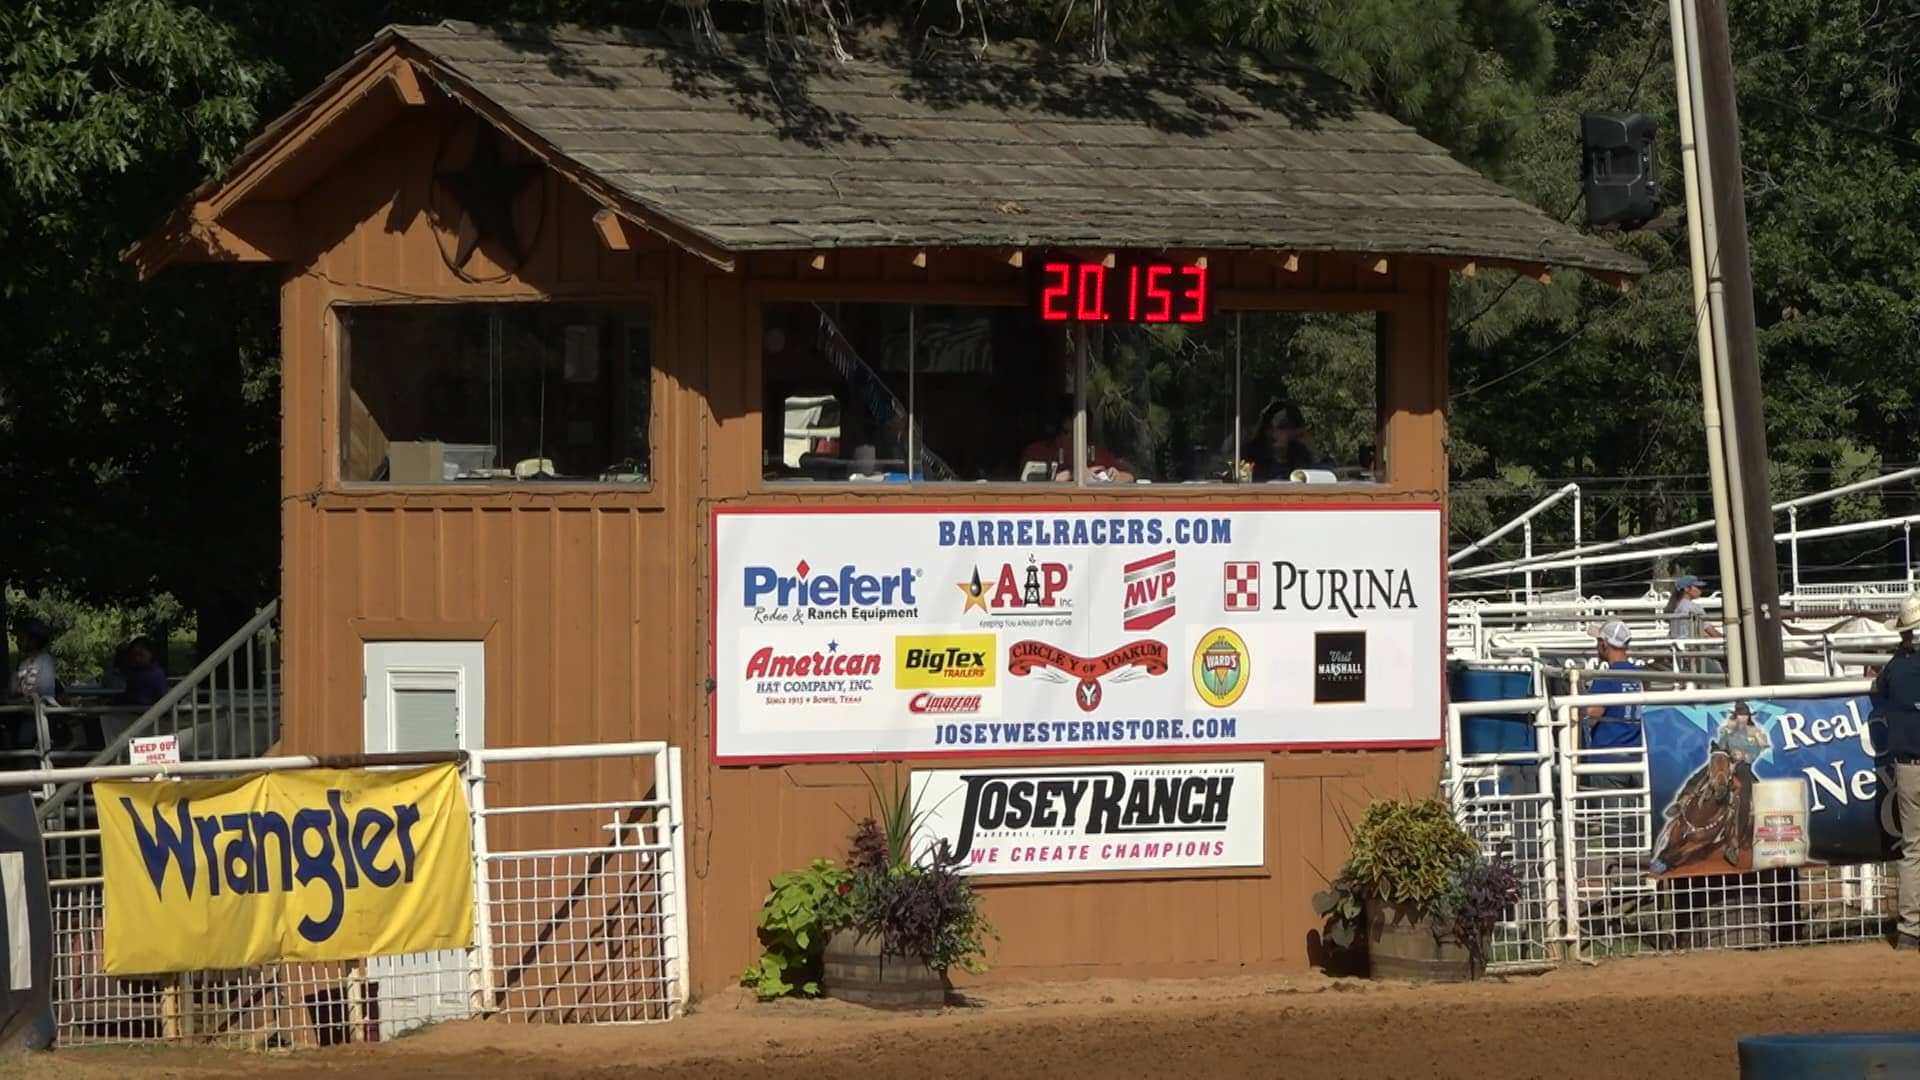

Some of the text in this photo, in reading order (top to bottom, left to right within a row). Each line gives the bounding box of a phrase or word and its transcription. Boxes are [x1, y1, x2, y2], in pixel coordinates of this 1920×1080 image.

[1043, 263, 1206, 322] 20.153
[938, 519, 1232, 546] BARRELRACERS.COM
[743, 560, 916, 607] Priefert
[1124, 571, 1176, 610] MVP
[1272, 561, 1418, 617] PURINA
[753, 606, 788, 623] Rodeo
[807, 607, 847, 620] Ranch
[851, 606, 918, 622] Equipment
[746, 646, 882, 681] American
[1012, 642, 1162, 673] CIRCLE Y OF YOAKUM
[1206, 655, 1237, 668] WARD'S
[1318, 663, 1362, 675] MARSHALL
[756, 679, 874, 694] HAT COMPANY, INC.
[943, 669, 985, 678] TRAILERS
[935, 717, 1237, 745] JOSEYWESTERNSTORE.COM
[1776, 699, 1860, 751] Real
[134, 741, 176, 753] KEEP OUT
[1802, 760, 1878, 812] Ne
[945, 771, 1235, 865] JOSEY RANCH
[119, 789, 420, 943] Wrangler
[971, 840, 1225, 863] WE CREATE CHAMPIONS
